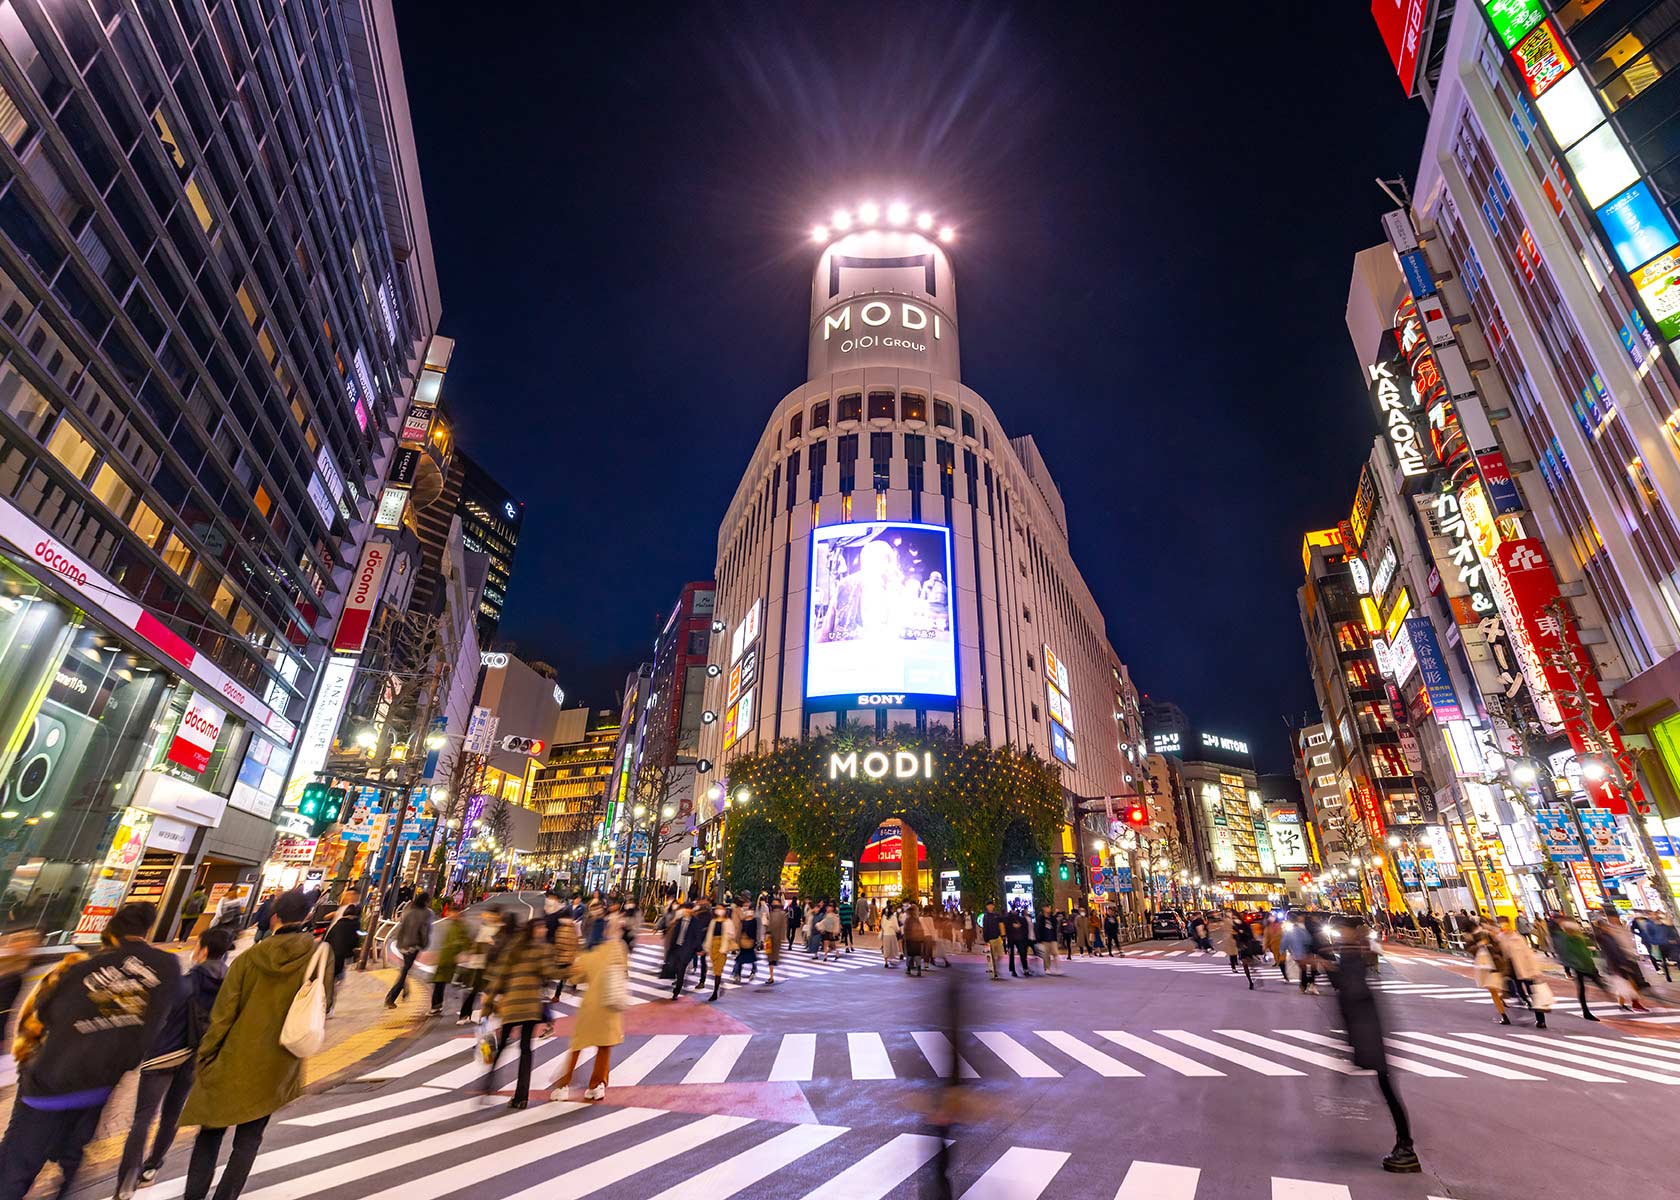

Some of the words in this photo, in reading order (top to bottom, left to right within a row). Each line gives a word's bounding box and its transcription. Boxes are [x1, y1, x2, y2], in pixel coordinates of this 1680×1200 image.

[824, 301, 940, 341] MODI
[883, 337, 926, 352] GROUP
[410, 410, 429, 419] TBC
[1368, 361, 1427, 477] KARAOKE
[35, 540, 87, 587] docomo
[355, 550, 383, 604] docomo
[480, 652, 507, 668] CO
[1413, 631, 1441, 684] 渋谷整形
[75, 680, 87, 695] Pro
[223, 681, 245, 704] docomo
[329, 676, 345, 707] AINZ
[857, 695, 906, 705] SONY
[184, 708, 219, 740] docomo
[314, 717, 333, 750] TULPE
[1153, 733, 1179, 746] ニトリ
[1154, 744, 1181, 753] NITORI
[1201, 733, 1219, 748] ニトリ
[1219, 737, 1249, 754] NITORI
[830, 752, 932, 779] MODI
[884, 884, 903, 892] MOD
[76, 914, 98, 932] TAX
